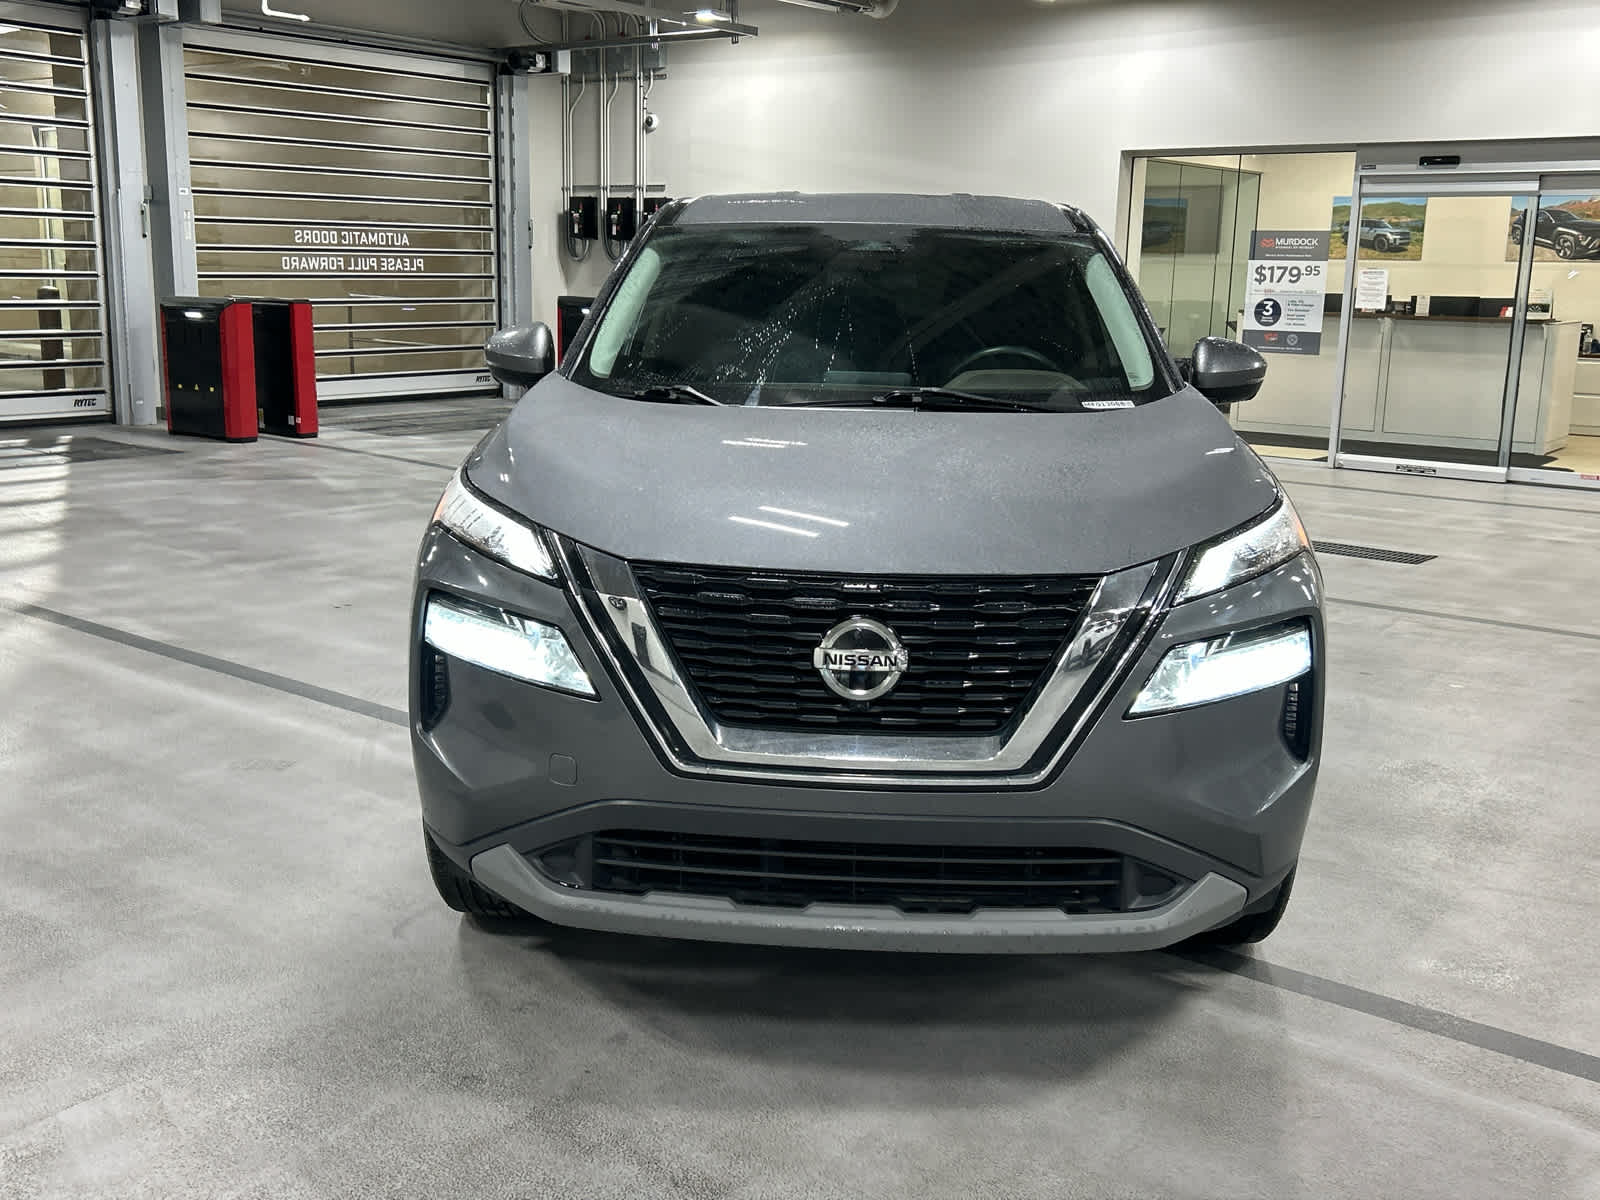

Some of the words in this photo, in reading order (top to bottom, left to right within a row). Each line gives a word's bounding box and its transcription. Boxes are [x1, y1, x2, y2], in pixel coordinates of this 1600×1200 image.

[1275, 237, 1319, 246] MURDOCK
[1254, 264, 1321, 285] $179.95
[1262, 300, 1274, 316] 3
[823, 653, 898, 667] NISSAN
